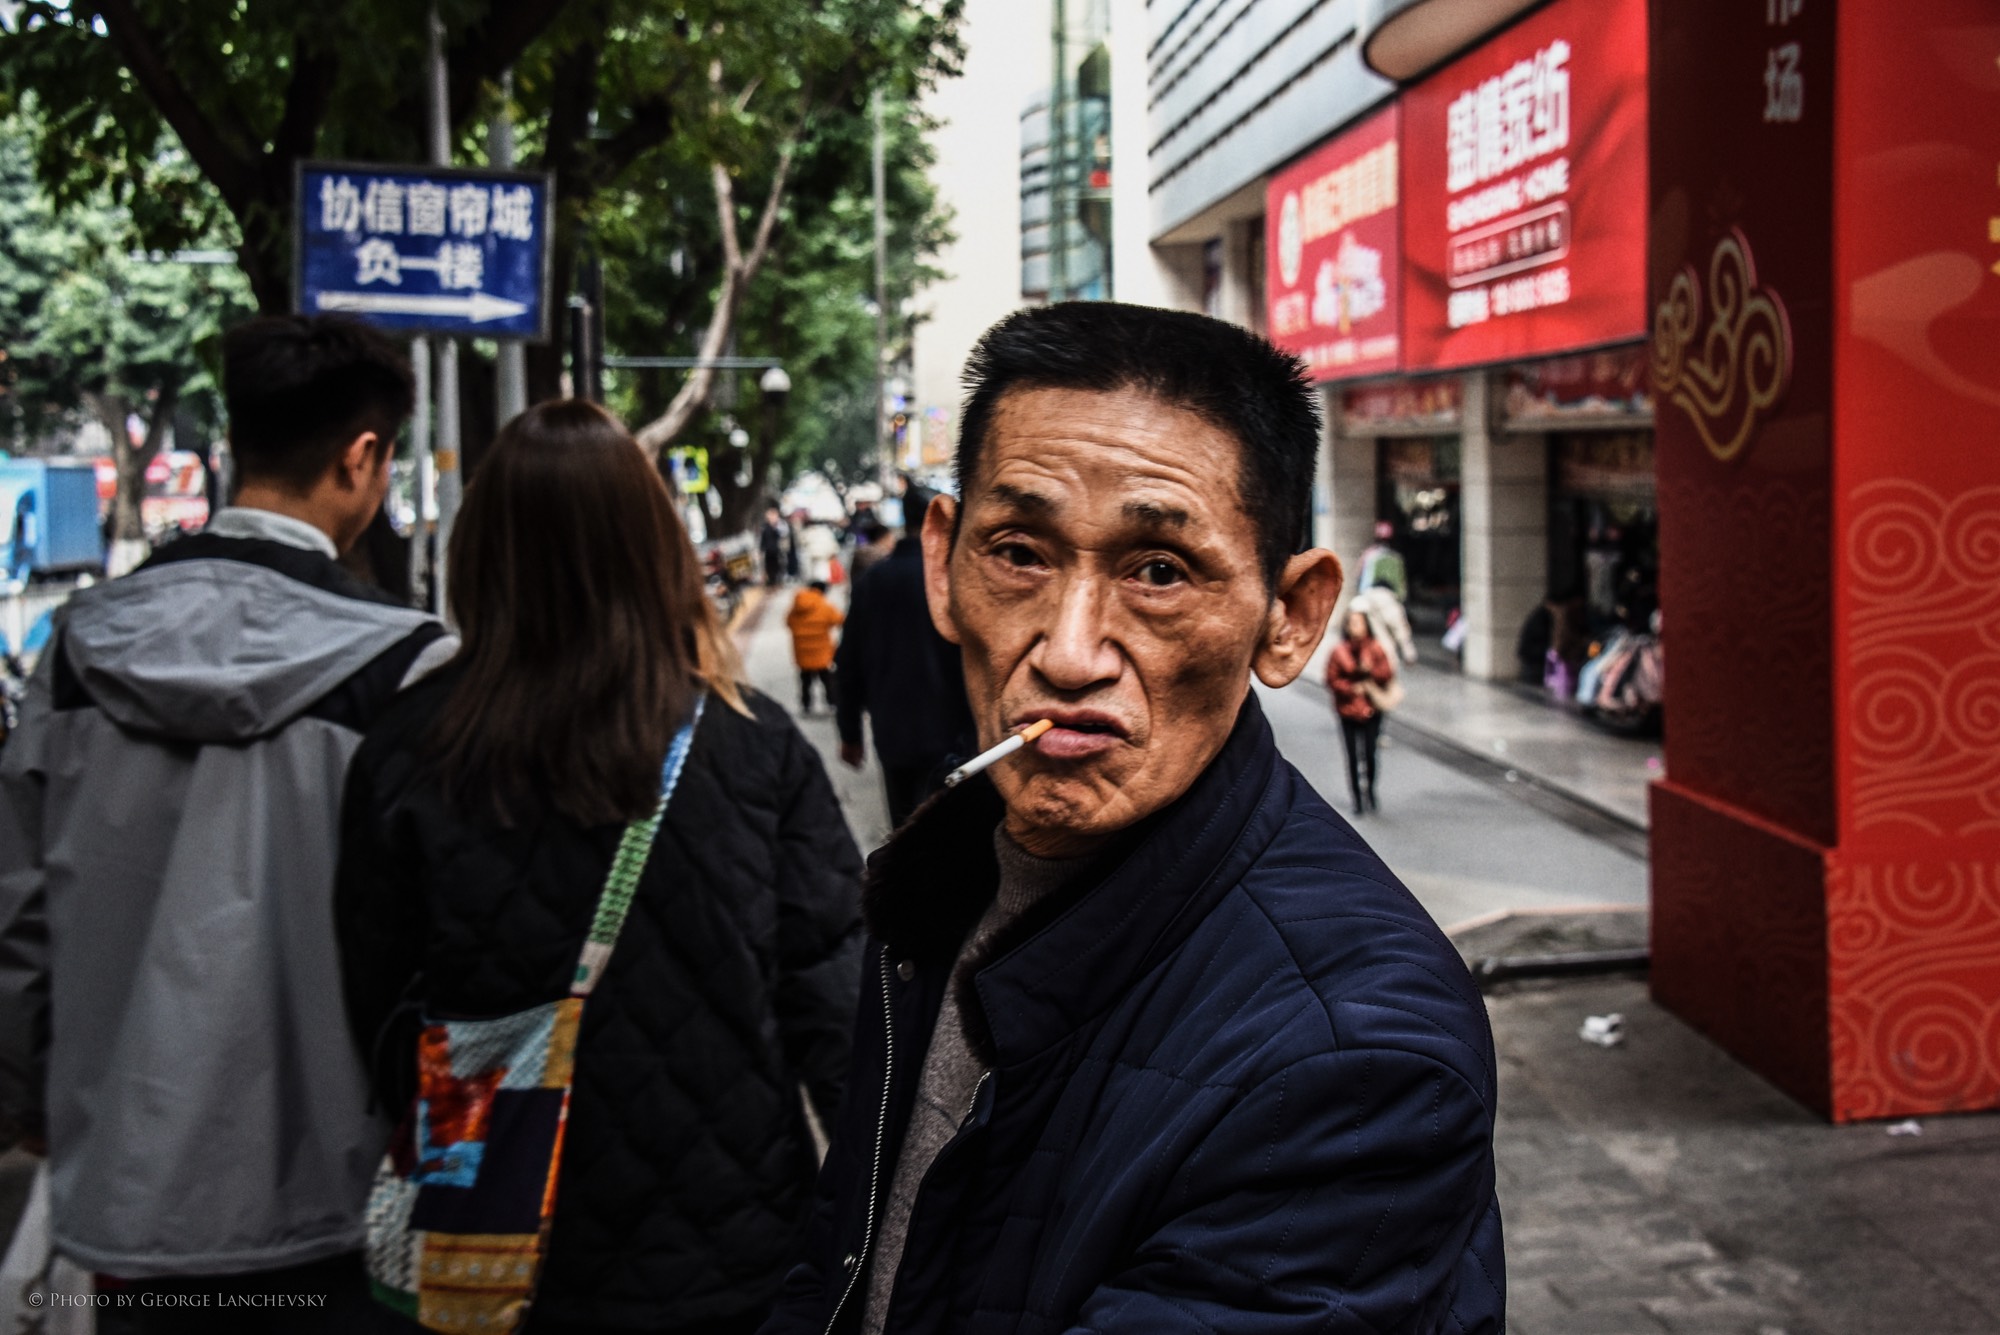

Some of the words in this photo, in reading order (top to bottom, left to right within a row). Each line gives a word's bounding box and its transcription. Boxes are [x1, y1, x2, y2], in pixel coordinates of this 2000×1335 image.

[320, 175, 534, 241] 协信窗帘城
[355, 237, 484, 290] 负一楼
